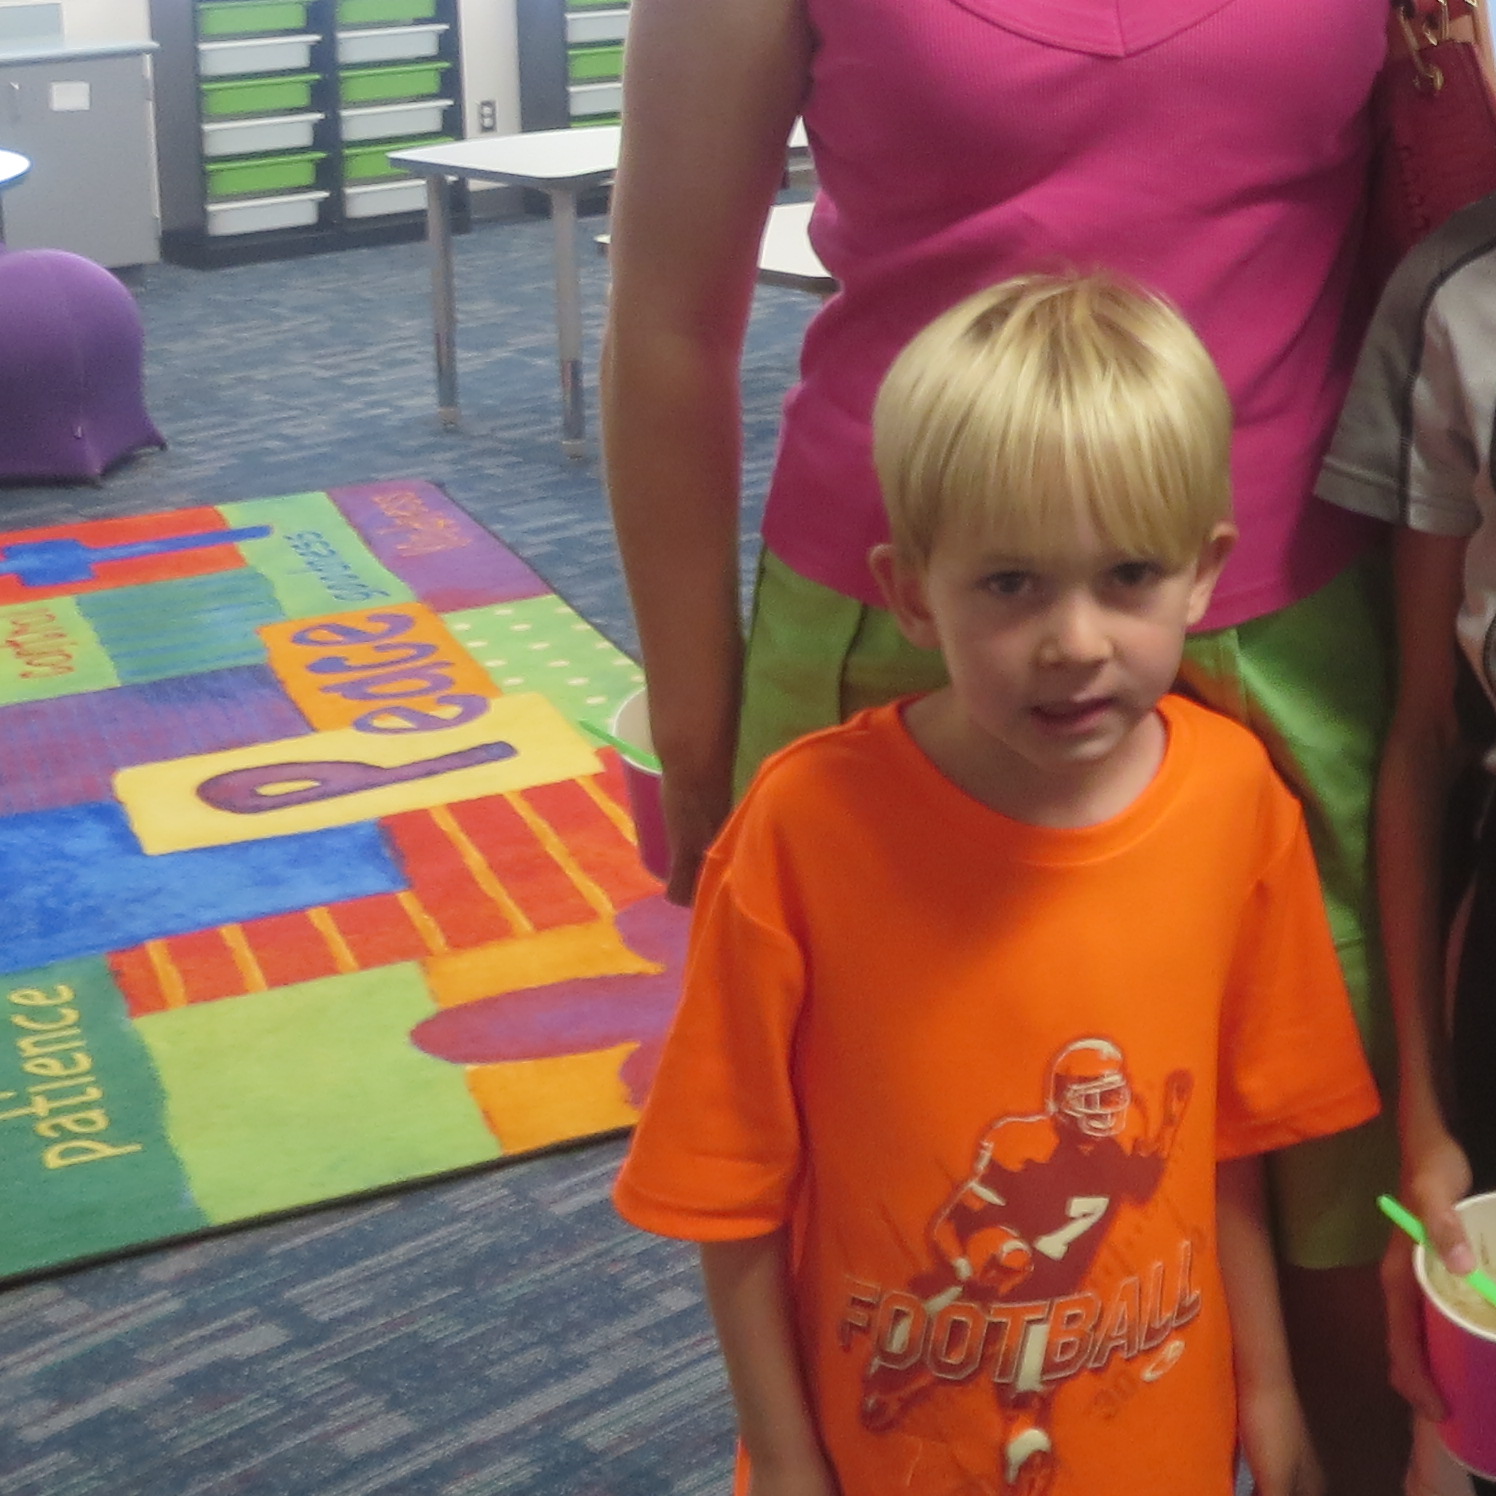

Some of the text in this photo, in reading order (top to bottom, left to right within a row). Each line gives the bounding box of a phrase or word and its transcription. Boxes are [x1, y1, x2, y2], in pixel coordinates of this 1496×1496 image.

[0, 984, 143, 1169] patience
[1034, 1196, 1110, 1260] 7
[838, 1241, 1201, 1385] FOOTBALL
